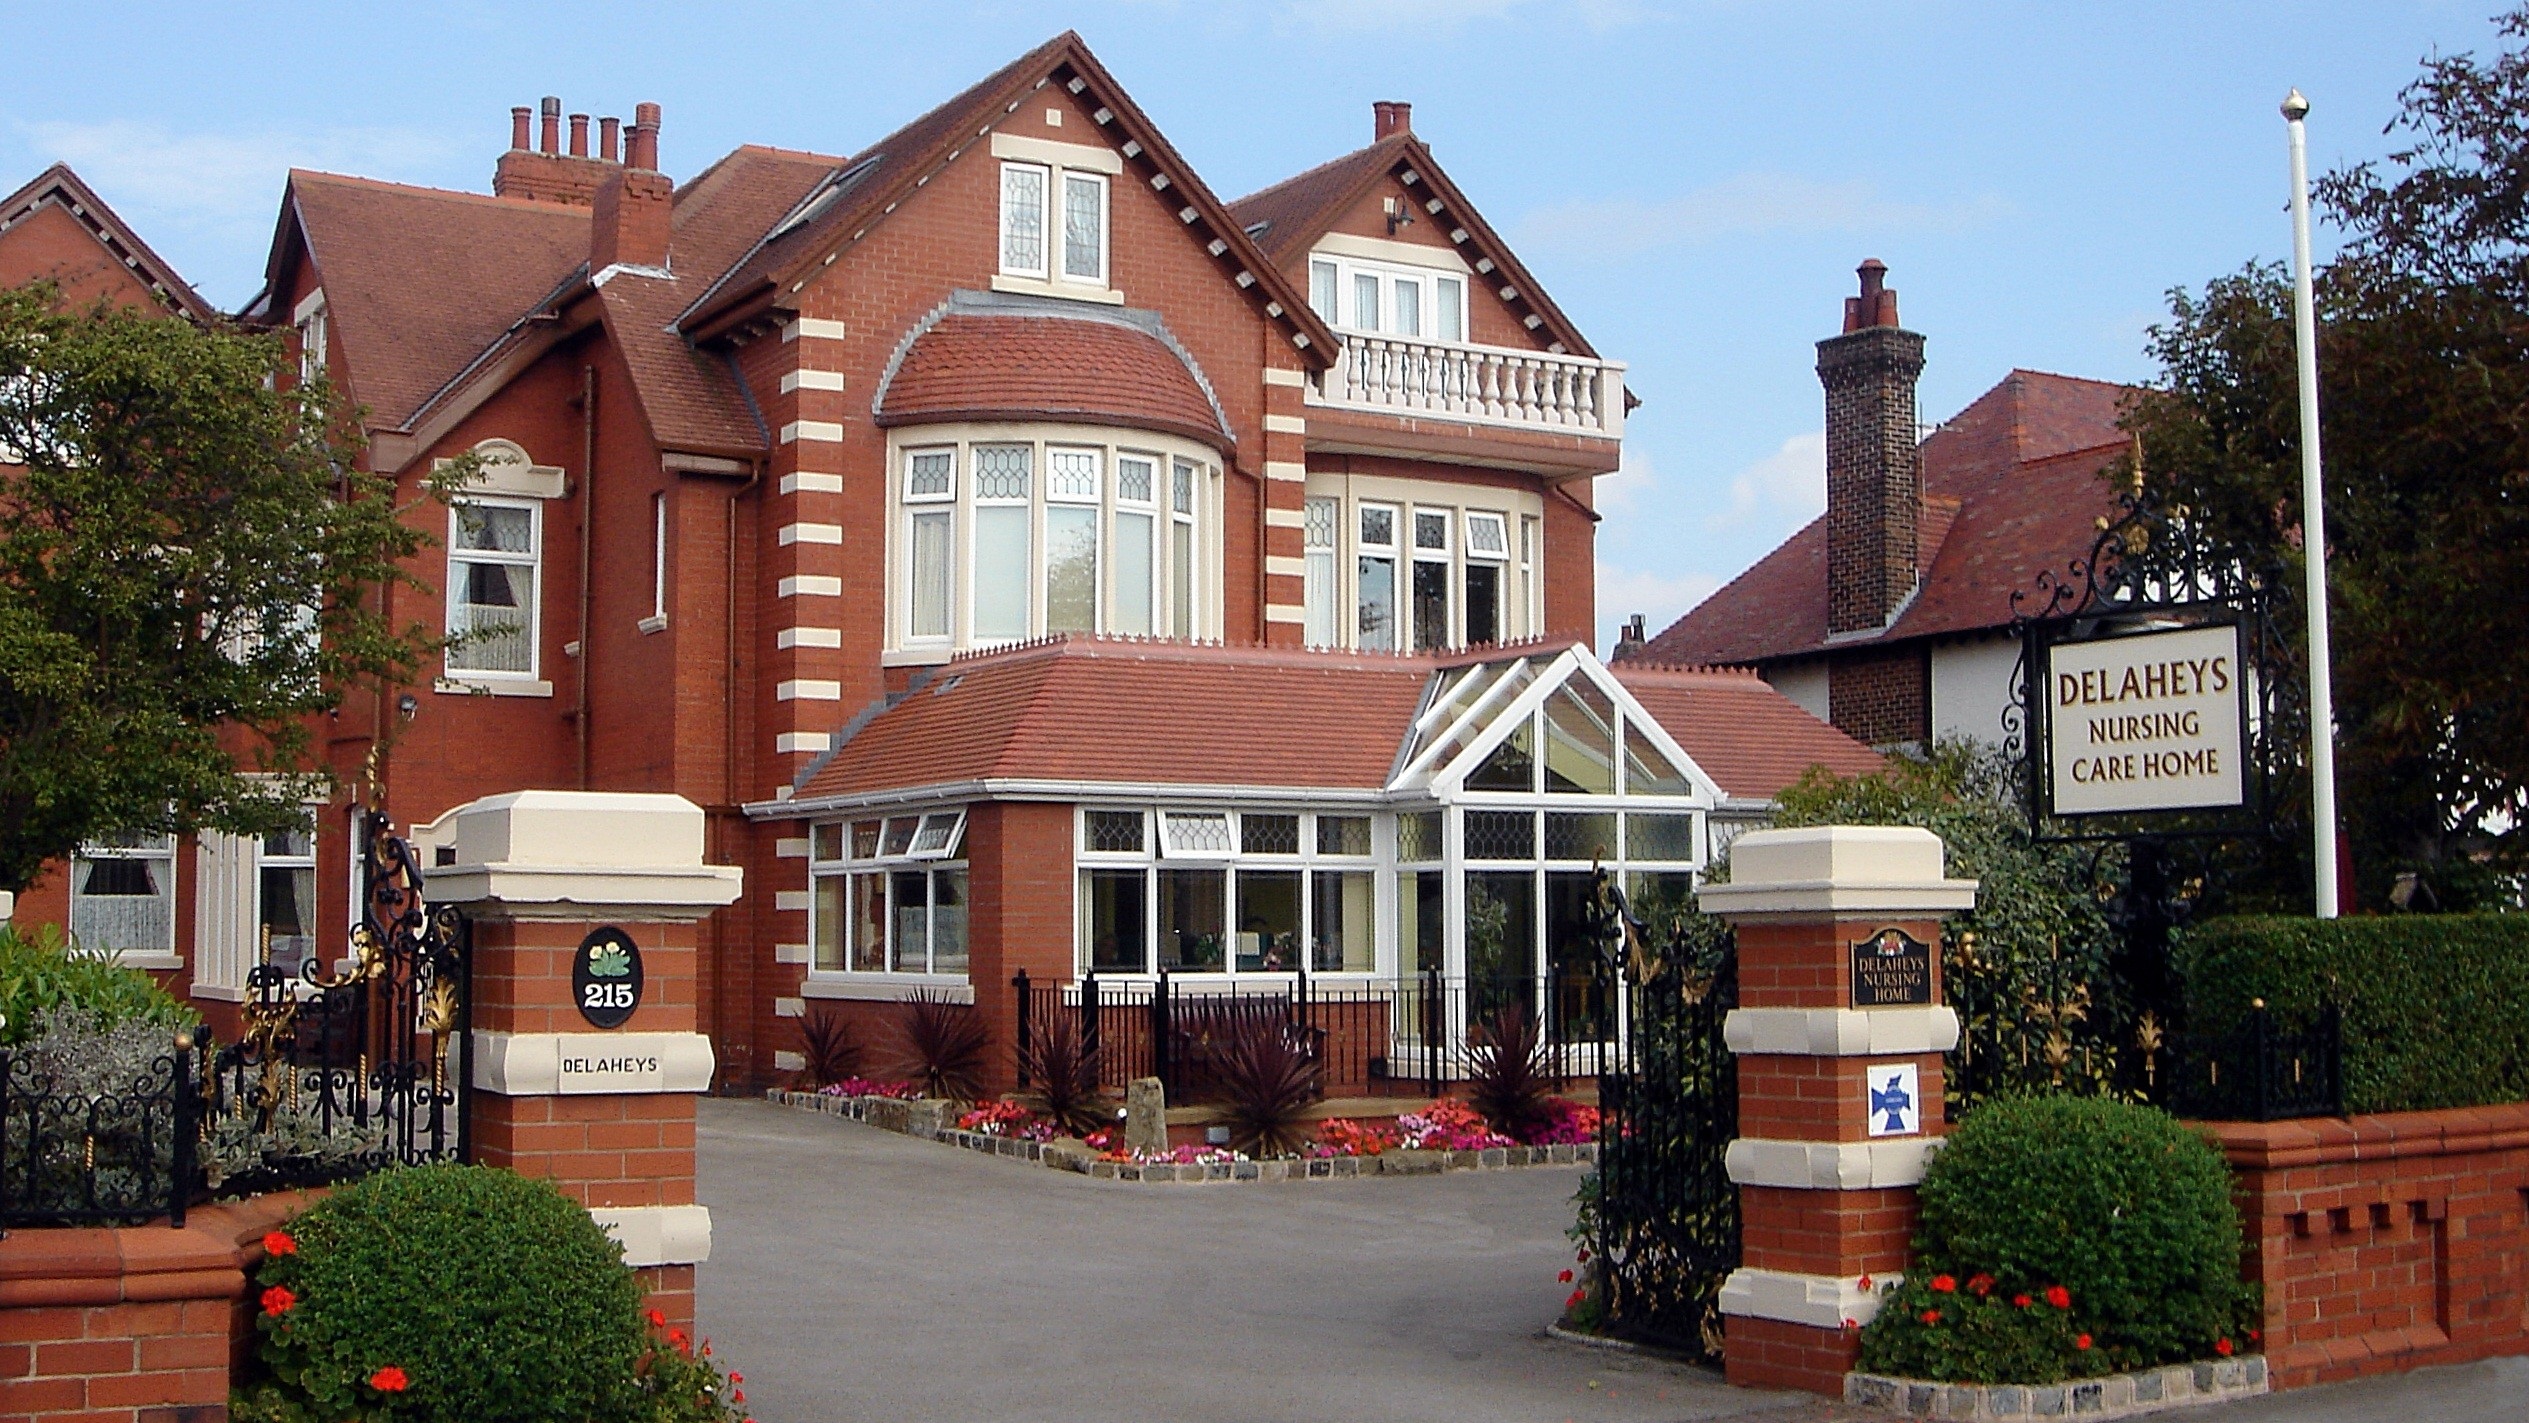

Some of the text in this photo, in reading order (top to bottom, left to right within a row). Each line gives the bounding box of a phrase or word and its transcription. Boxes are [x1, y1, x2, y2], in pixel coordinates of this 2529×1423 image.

[2058, 657, 2229, 706] DELAHEYS
[2088, 711, 2200, 743] NURSING
[2071, 749, 2219, 783] CARE HOME
[1859, 957, 1925, 972] DELAHEYS
[1863, 973, 1921, 987] NURSING
[584, 983, 634, 1008] 215
[1874, 987, 1912, 1002] HOME
[563, 1058, 658, 1074] DELAHEYS
